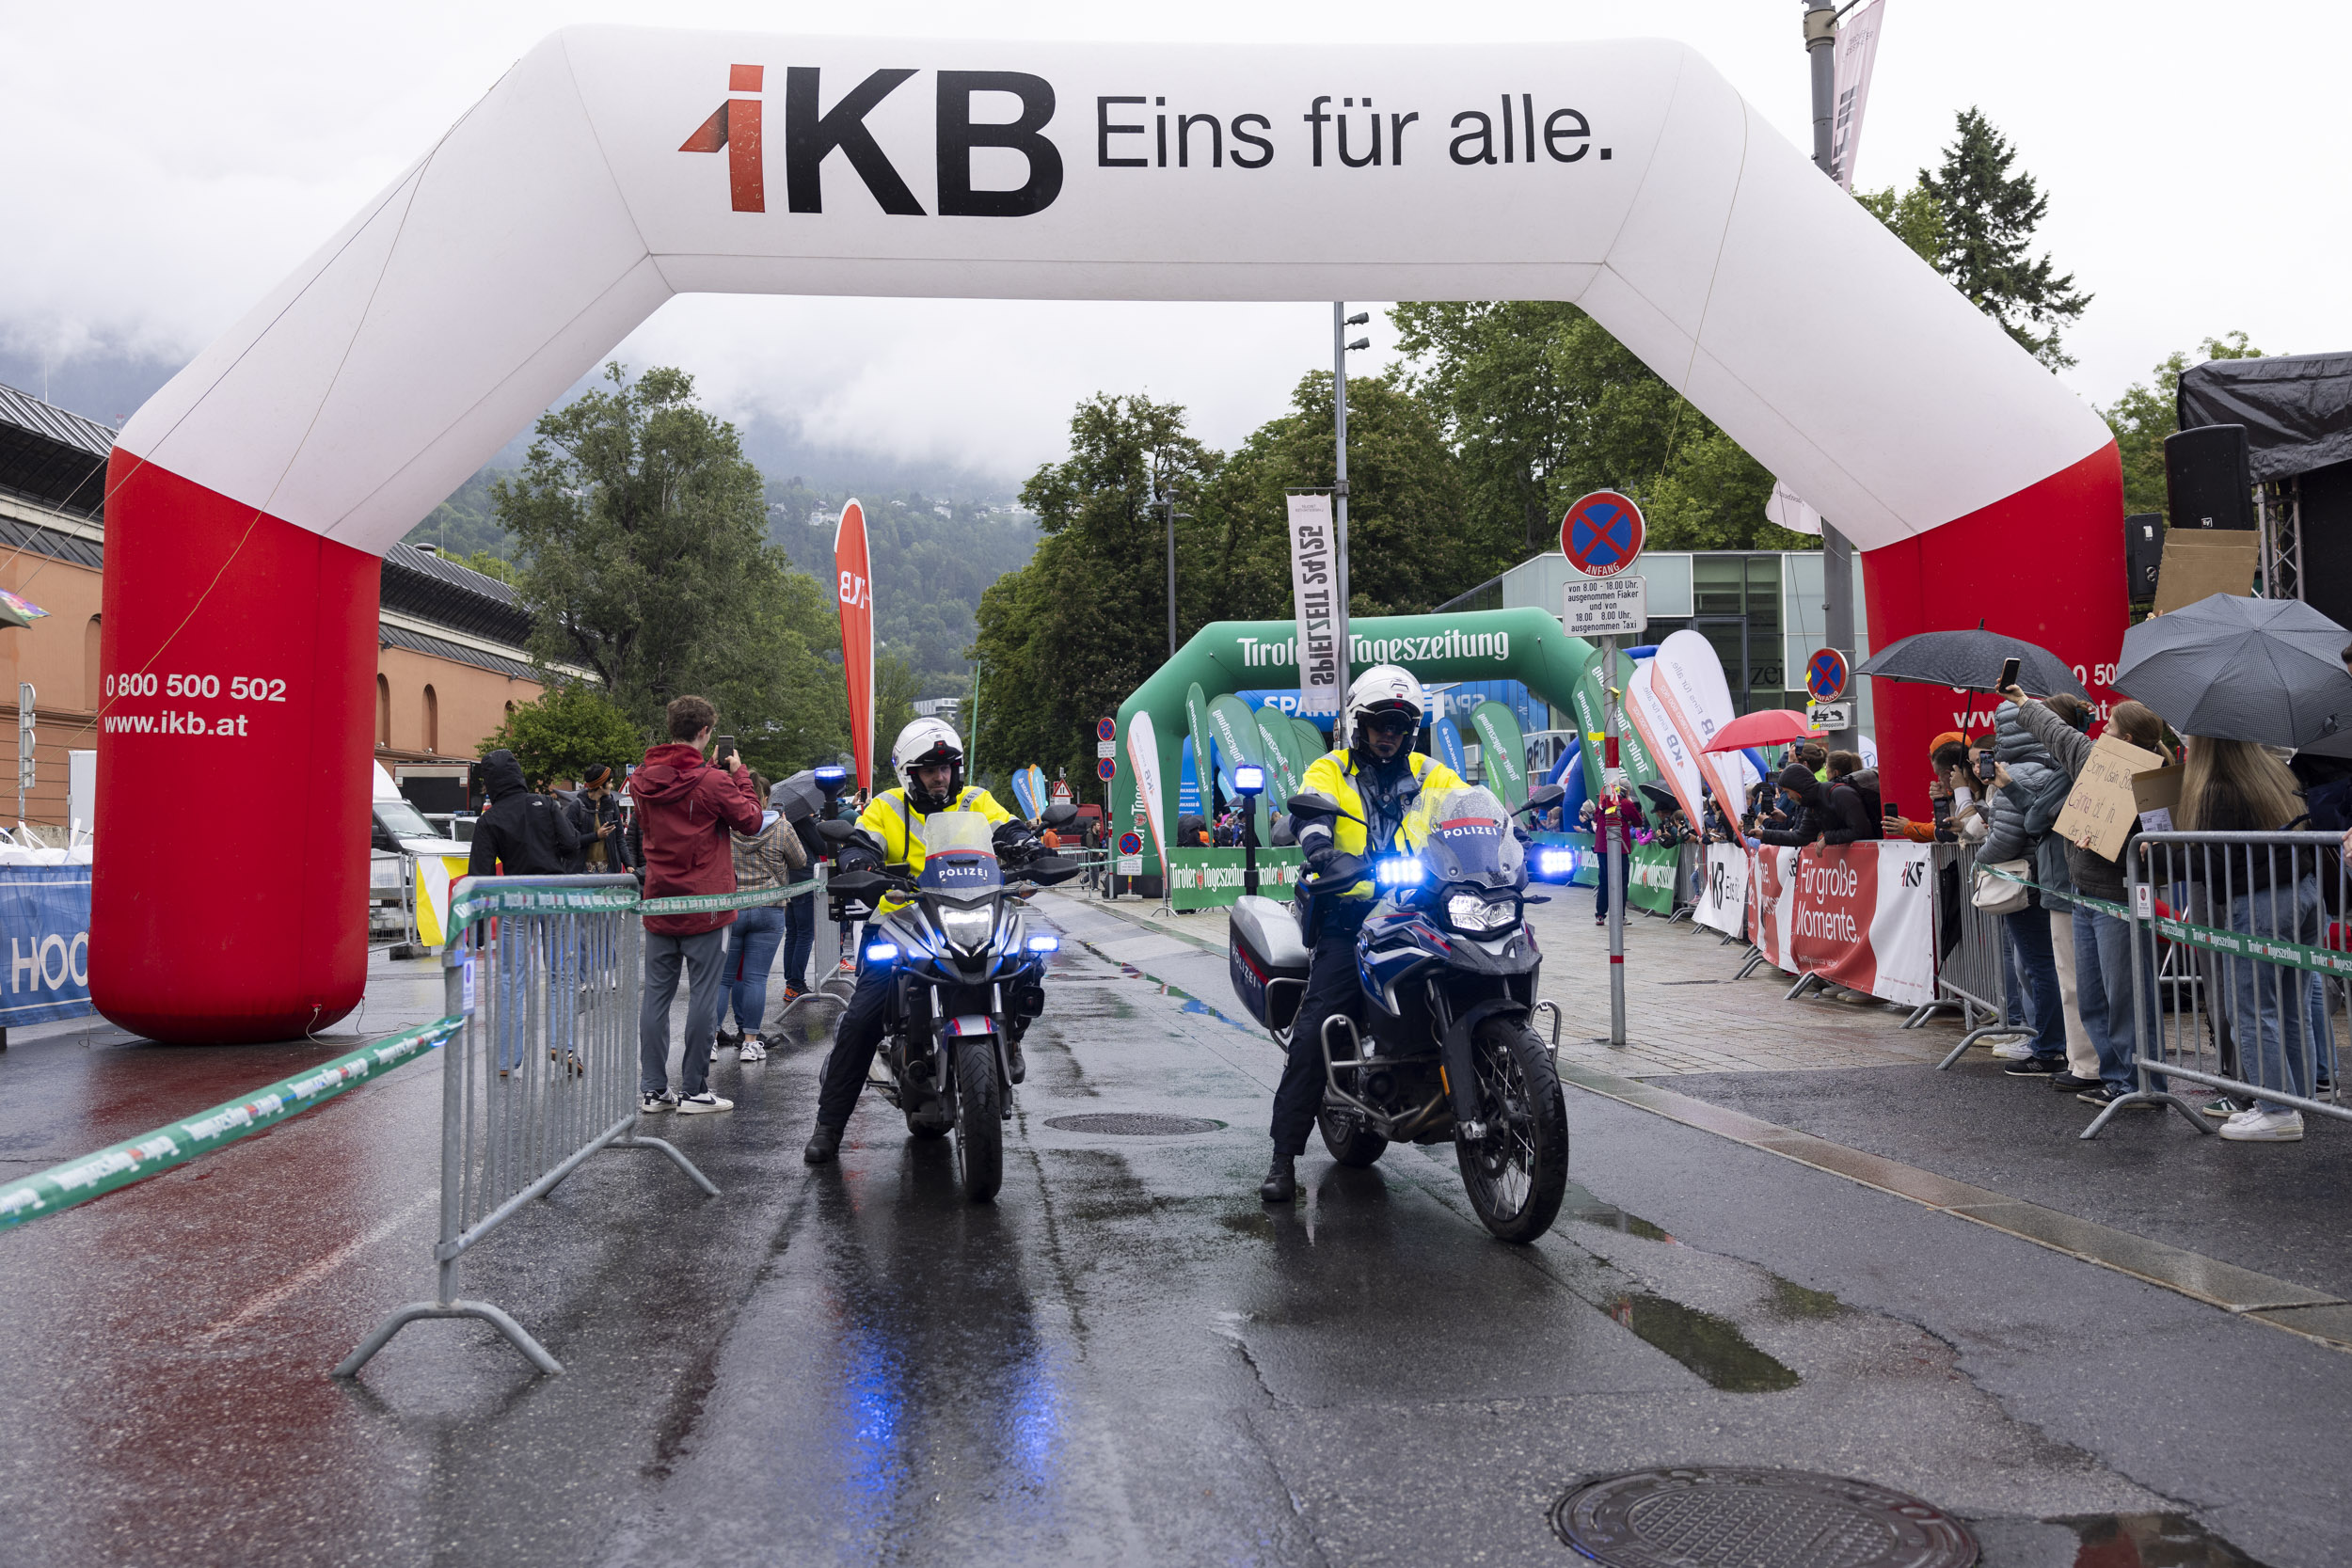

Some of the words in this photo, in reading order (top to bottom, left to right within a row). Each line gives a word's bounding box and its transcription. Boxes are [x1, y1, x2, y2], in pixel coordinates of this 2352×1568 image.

[1096, 95, 1274, 168] Eins
[1304, 94, 1419, 168] für
[1448, 93, 1614, 165] alle.
[1584, 562, 1620, 576] ANFANG
[1568, 593, 1615, 603] ausgenommen
[1617, 590, 1639, 599] Fiaker
[1583, 582, 1597, 592] 8.00
[1606, 581, 1623, 591] 18.00
[1576, 612, 1593, 622] 18.00
[1601, 611, 1615, 620] 8.00
[1590, 602, 1602, 610] und
[1571, 622, 1620, 633] ausgenommen
[1623, 621, 1637, 629] Taxi
[1236, 638, 1299, 667] Tirol
[1349, 629, 1509, 667] Tageszeitung
[2093, 663, 2119, 686] 50
[119, 673, 158, 697] 800
[166, 673, 220, 698] 500
[230, 676, 286, 702] 502
[1813, 690, 1838, 703] ANFANG
[104, 710, 248, 736] www.ikb.at
[1443, 826, 1498, 839] POLIZEI
[939, 867, 988, 879] POLIZEI
[1169, 863, 1196, 889] Tiroler
[1201, 863, 1247, 893] Tageszeitun
[1801, 858, 1816, 894] Für
[1817, 859, 1858, 905] große
[1796, 900, 1861, 943] Momente.
[2266, 942, 2301, 964] Tageszeitung
[2310, 951, 2328, 967] Tiroler
[2331, 955, 2352, 972] Tagesz
[1231, 945, 1257, 986] POLIZEI
